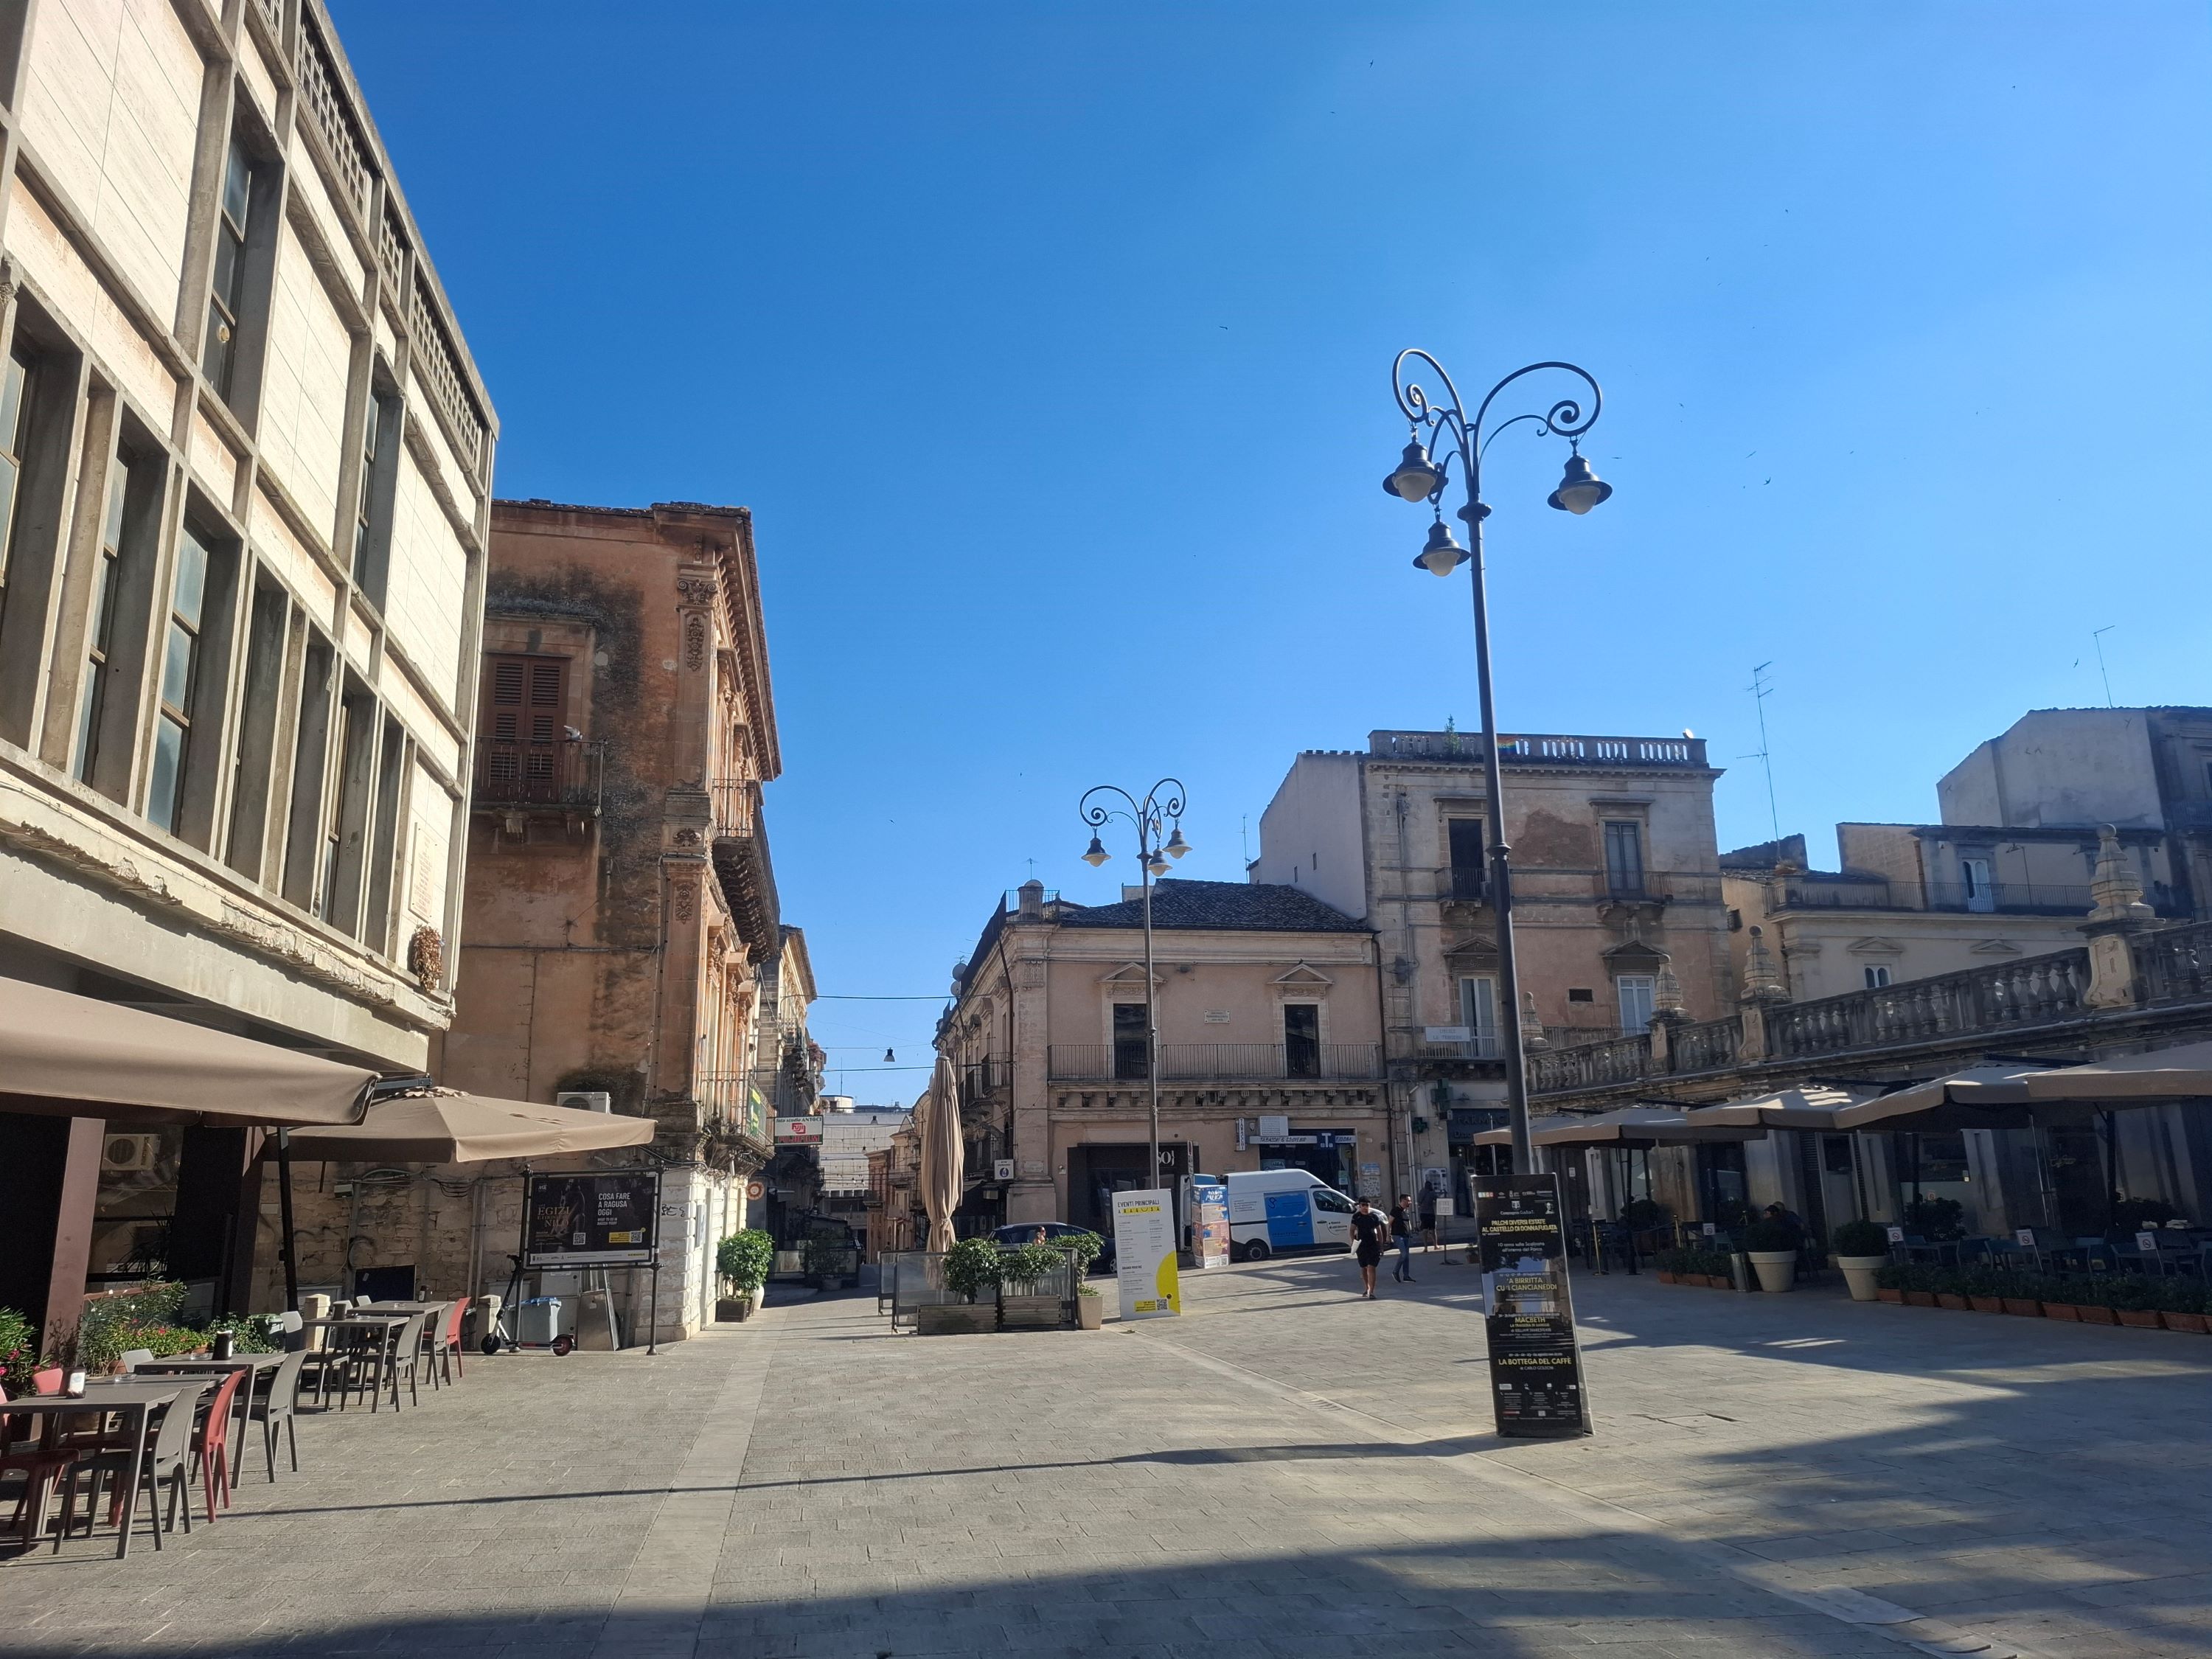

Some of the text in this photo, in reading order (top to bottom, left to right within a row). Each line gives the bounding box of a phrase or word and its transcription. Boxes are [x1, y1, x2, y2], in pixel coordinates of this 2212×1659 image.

[538, 1206, 570, 1215] EGIZI
[545, 1220, 569, 1228] NILO
[1551, 1356, 1573, 1364] CAFFÈ
